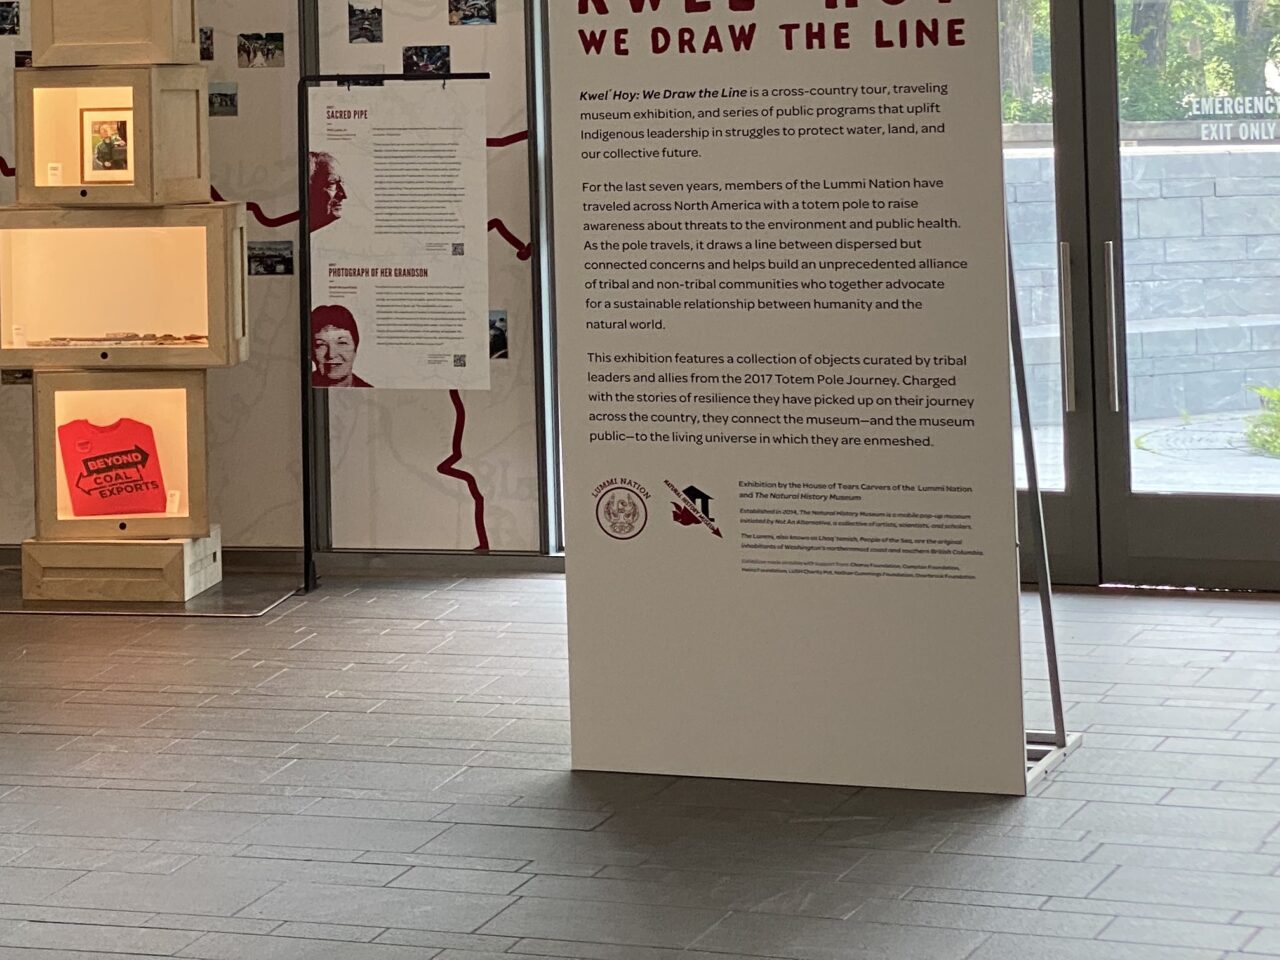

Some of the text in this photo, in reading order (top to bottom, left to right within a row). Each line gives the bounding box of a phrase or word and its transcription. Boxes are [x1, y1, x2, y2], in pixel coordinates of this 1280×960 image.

[578, 18, 966, 56] WE DRAW THE LINE
[613, 90, 640, 102] Hoy:
[643, 89, 660, 99] We
[663, 88, 696, 99] Draw
[699, 87, 719, 98] the
[721, 86, 747, 98] Line
[750, 89, 759, 97] is
[762, 88, 769, 97] a
[772, 85, 858, 99] cross-country
[861, 84, 890, 96] tour,
[893, 82, 948, 96] traveling
[326, 110, 368, 119] SACRED PIPE
[580, 102, 941, 120] museum exhibition, and series of public programs that uplift
[581, 122, 945, 142] Indigenous leadership in struggles to protect water, land, and
[1201, 122, 1277, 140] EXIT ONLY
[581, 146, 701, 159] our collective future.
[329, 268, 428, 277] PHOTOGRAPH OF HER GRANDSON
[586, 319, 666, 330] natural world.
[587, 352, 967, 368] This exhibition features a collection of objects curated by tribal
[588, 371, 956, 389] leaders and allies from the 2017 Totem Pole Journey. Charged
[88, 453, 141, 470] BEYOND
[94, 472, 132, 485] COAL
[99, 481, 159, 498] EXPORTS
[591, 477, 652, 500] LUMMI NATION
